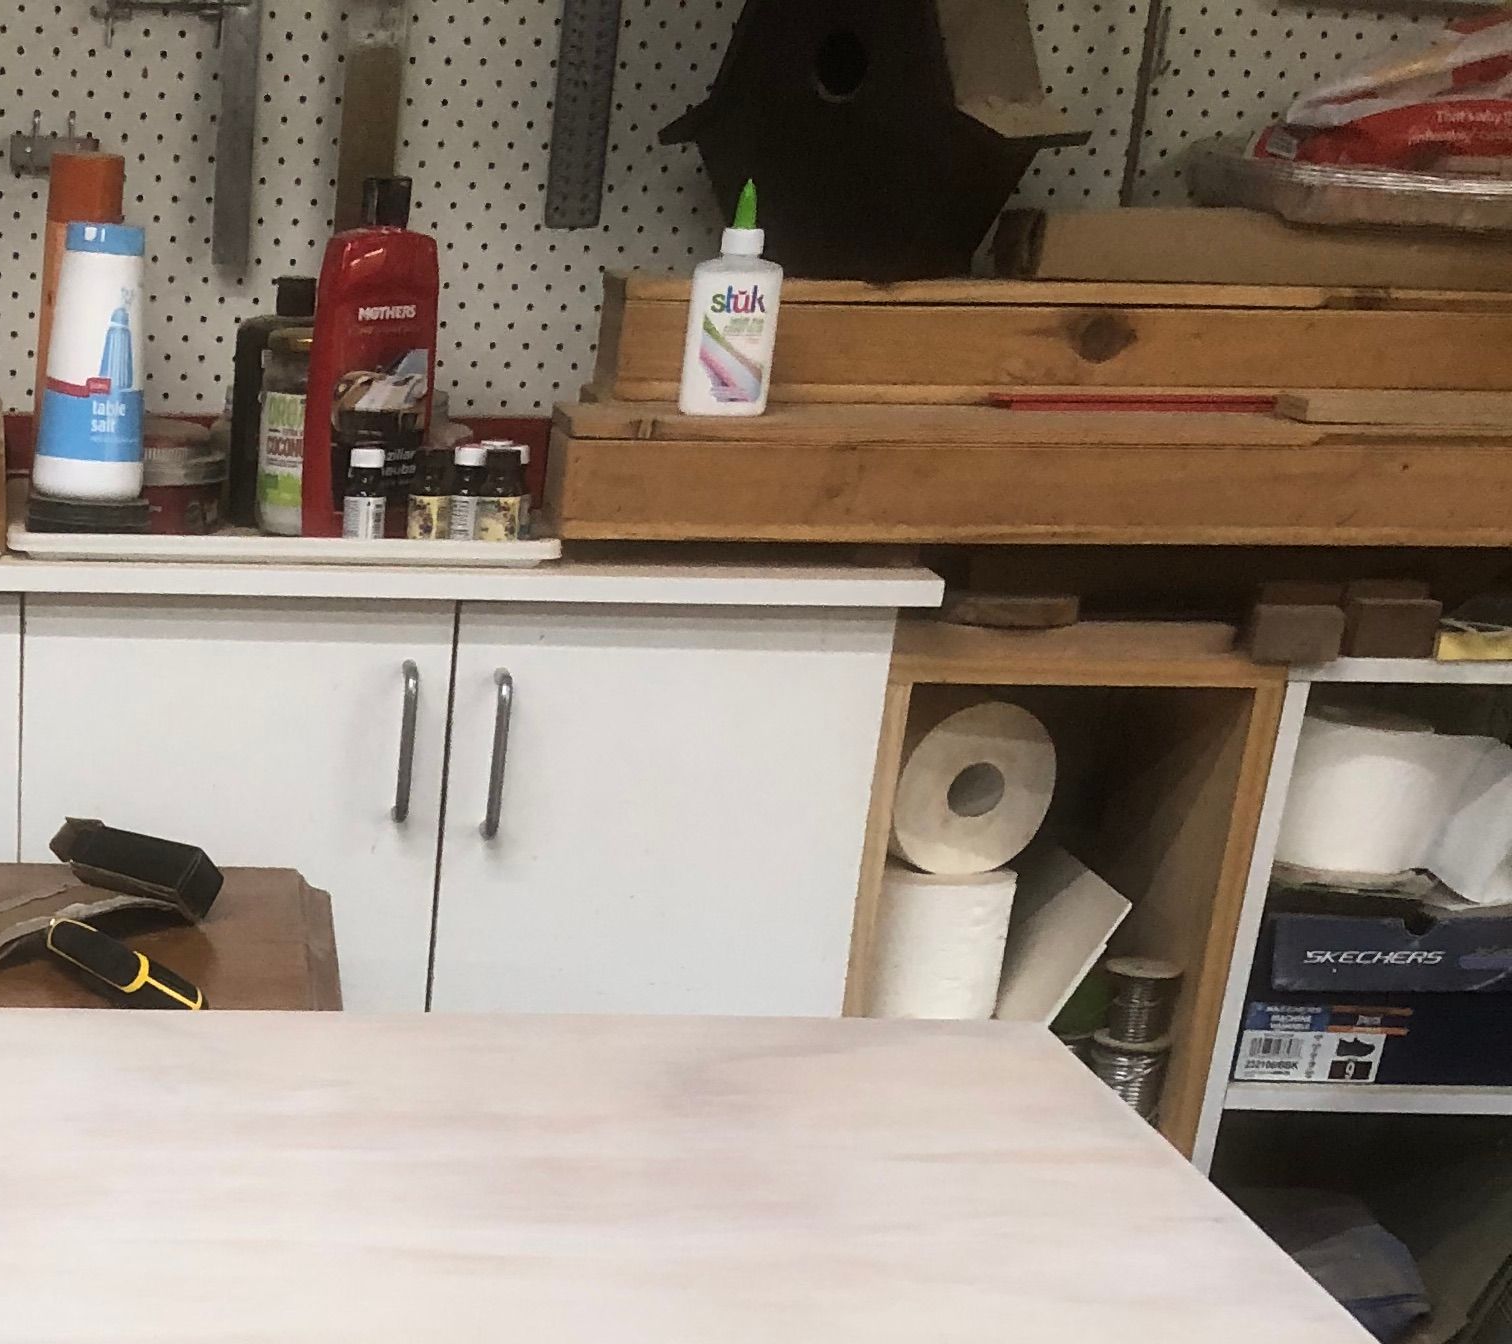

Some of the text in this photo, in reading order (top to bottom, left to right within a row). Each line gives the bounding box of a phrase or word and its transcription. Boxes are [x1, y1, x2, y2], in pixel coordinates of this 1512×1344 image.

[358, 304, 417, 320] MOTHERS
[92, 399, 126, 417] table
[90, 419, 116, 433] salt
[1303, 950, 1446, 965] SKECHERS
